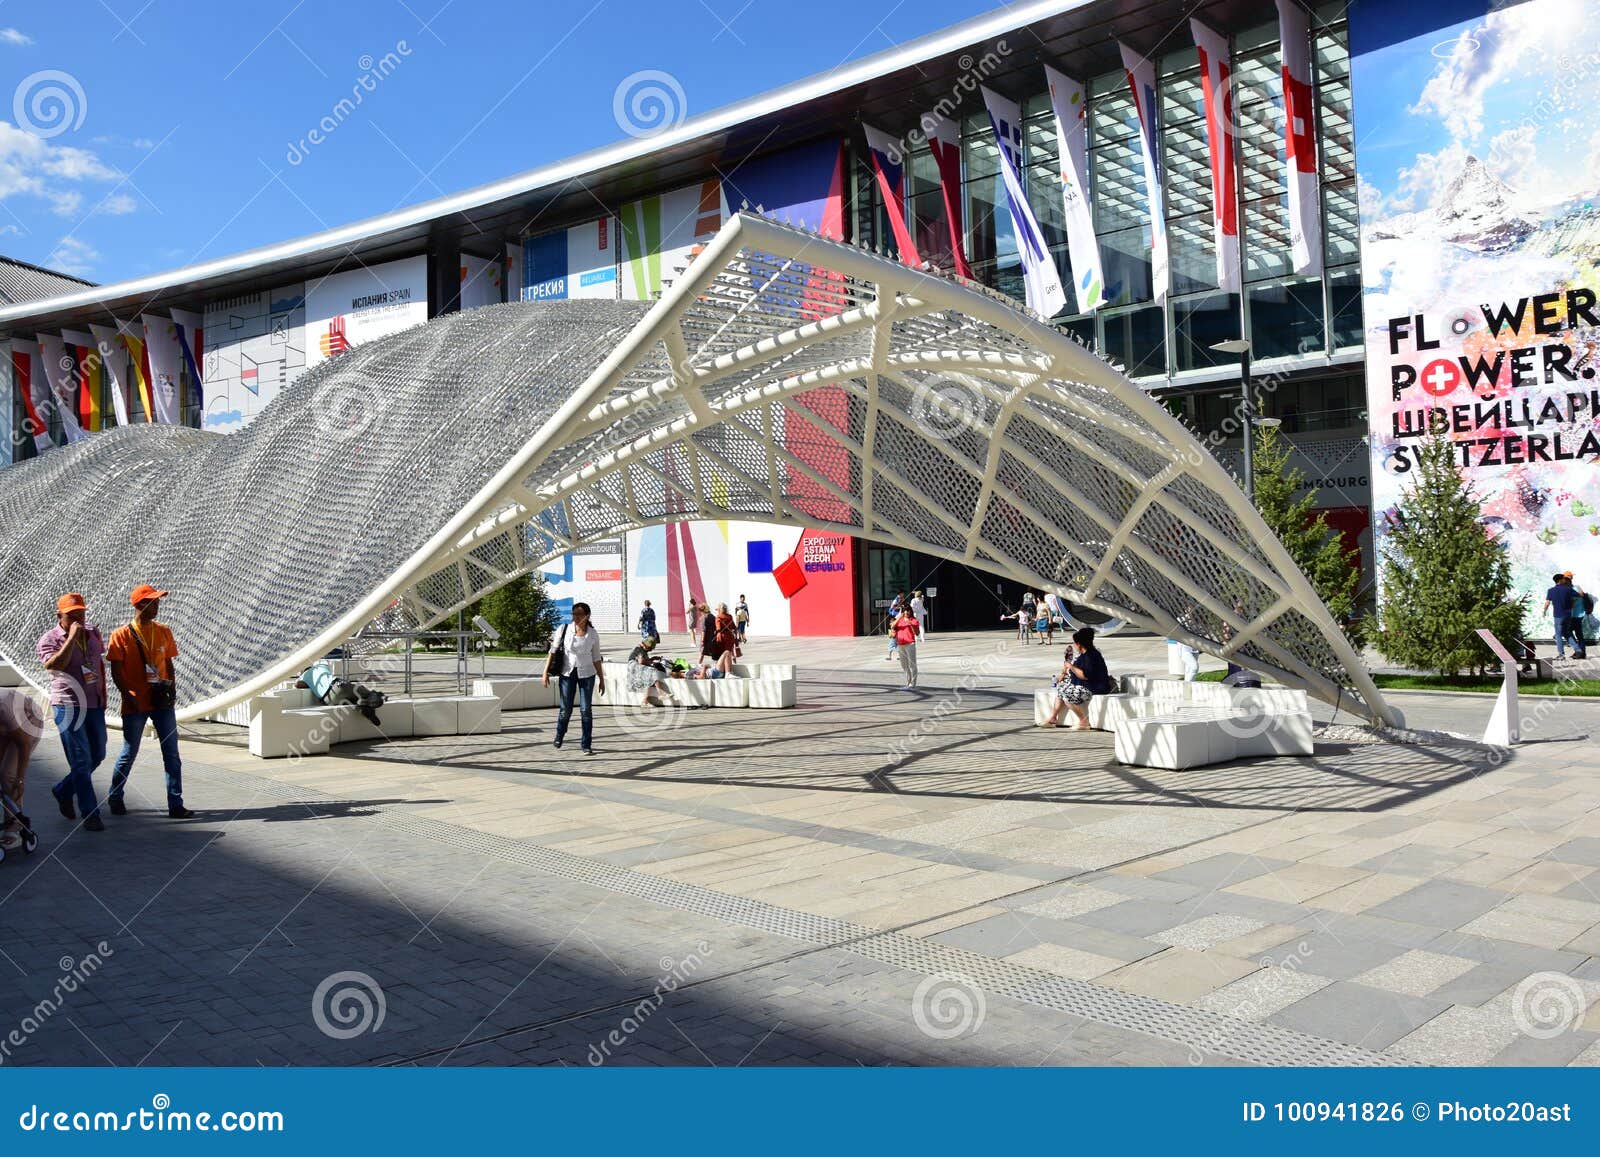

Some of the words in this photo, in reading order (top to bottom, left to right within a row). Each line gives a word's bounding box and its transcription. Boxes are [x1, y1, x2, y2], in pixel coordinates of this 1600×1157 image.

[352, 293, 388, 309] ИСПАНИЯ
[389, 287, 411, 302] SPAIN
[528, 279, 564, 300] ГРЕКИЯ
[1392, 429, 1600, 473] STZERLA
[803, 545, 836, 555] ASTANA
